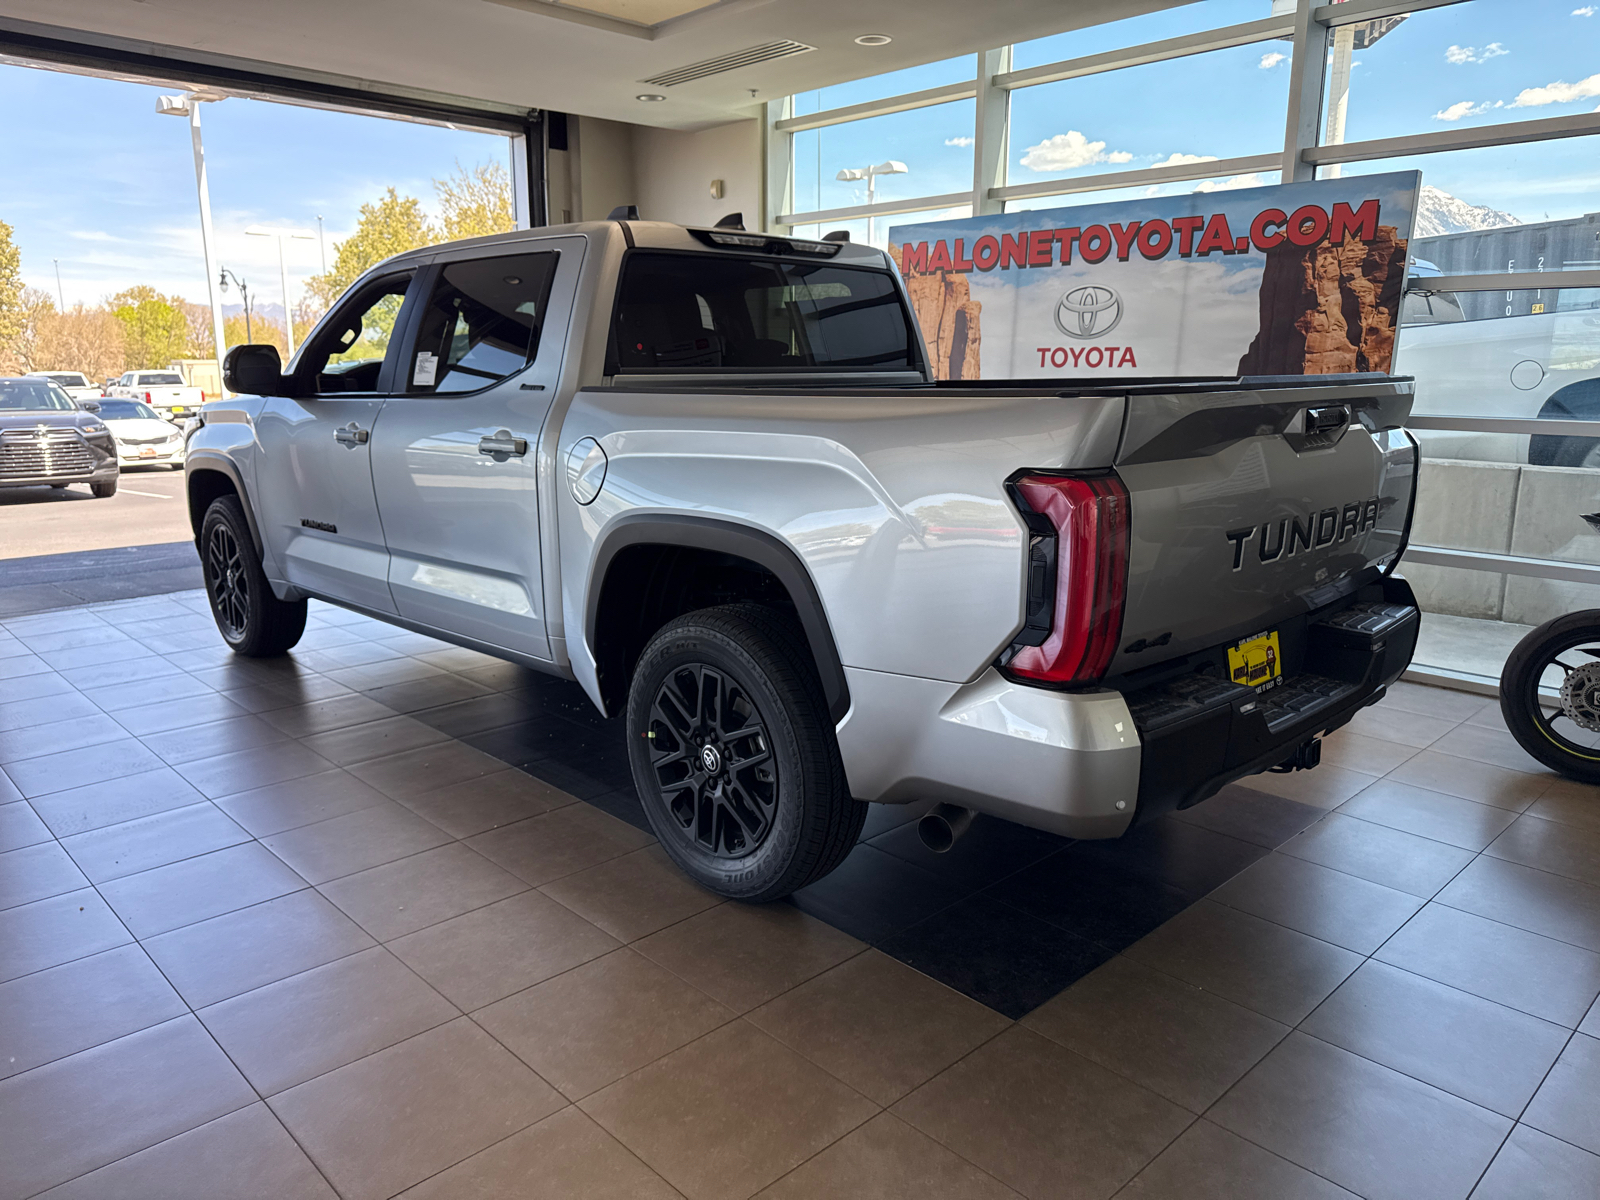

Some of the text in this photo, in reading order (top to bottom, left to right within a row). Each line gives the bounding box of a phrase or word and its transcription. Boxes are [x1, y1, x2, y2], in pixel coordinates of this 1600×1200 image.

[902, 199, 1381, 277] MALONETOYOTA.COM
[1036, 346, 1137, 368] TOYOTA
[300, 518, 338, 533] TUNDRA
[1226, 495, 1381, 572] TUNDRA
